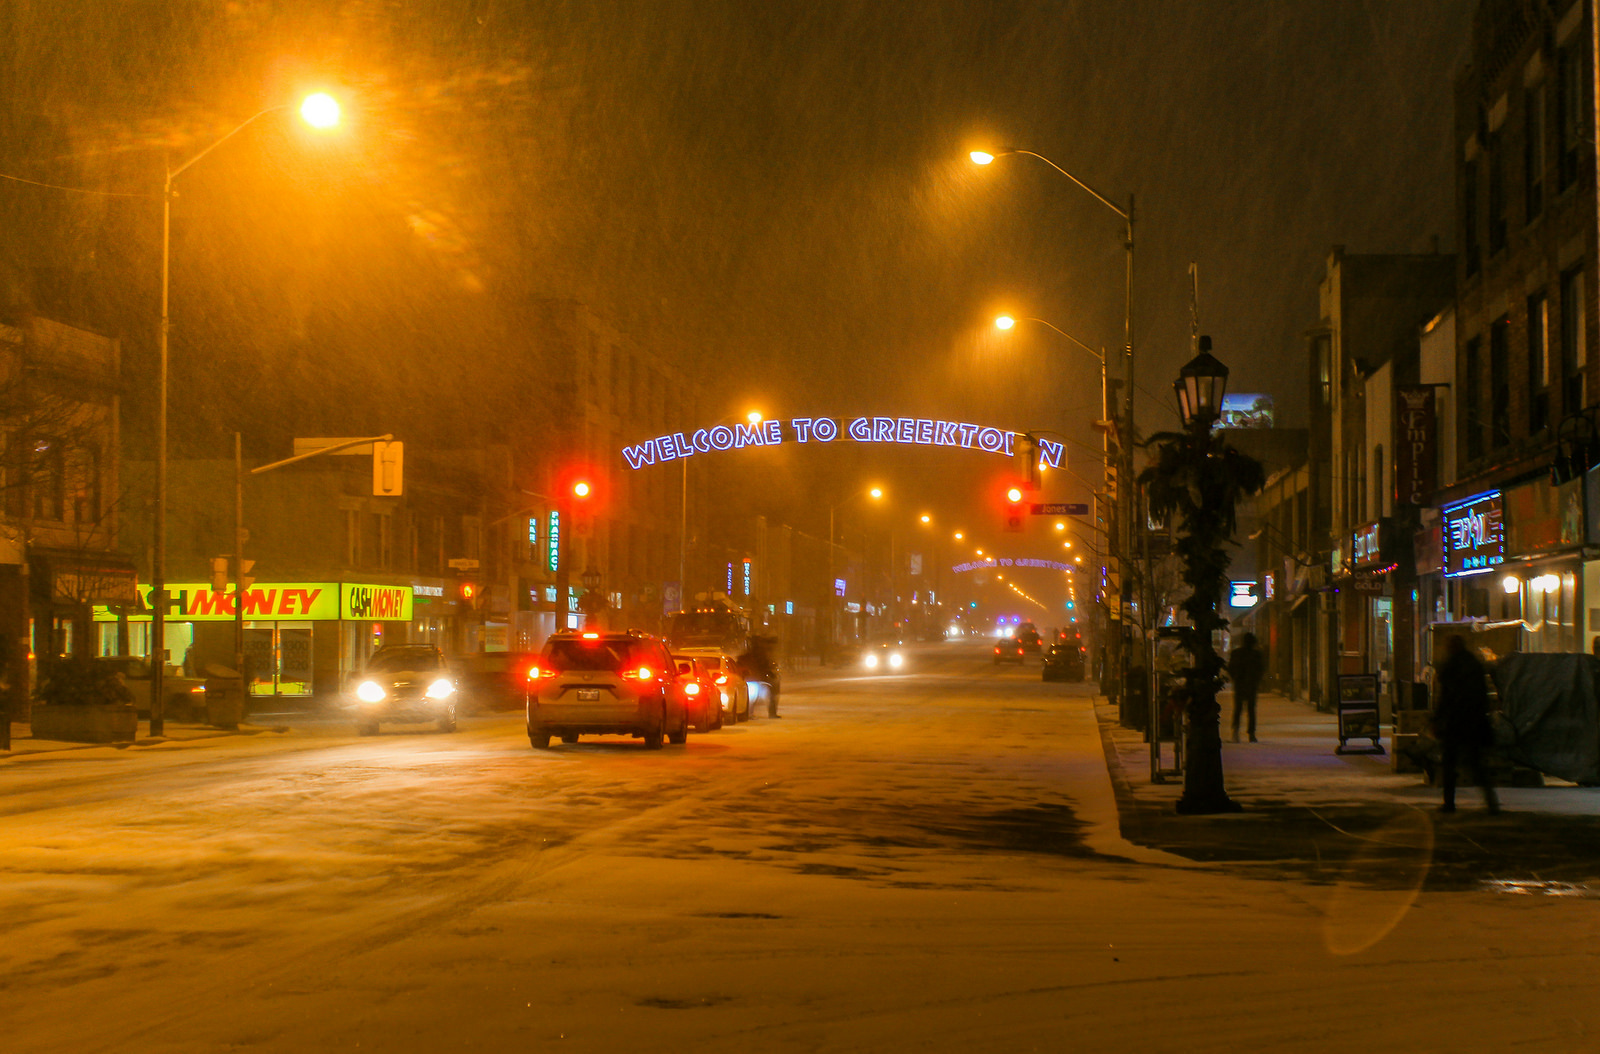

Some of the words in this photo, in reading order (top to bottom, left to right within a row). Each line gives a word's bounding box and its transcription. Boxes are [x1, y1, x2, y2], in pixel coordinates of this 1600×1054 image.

[622, 420, 782, 470] WELCOME
[792, 417, 838, 443] TO
[849, 417, 1064, 468] GREEKTON
[1401, 411, 1427, 505] Empire
[1042, 504, 1067, 513] Jones
[550, 511, 559, 571] PHARMACY
[1000, 558, 1013, 567] TO
[1354, 581, 1382, 591] GOLD
